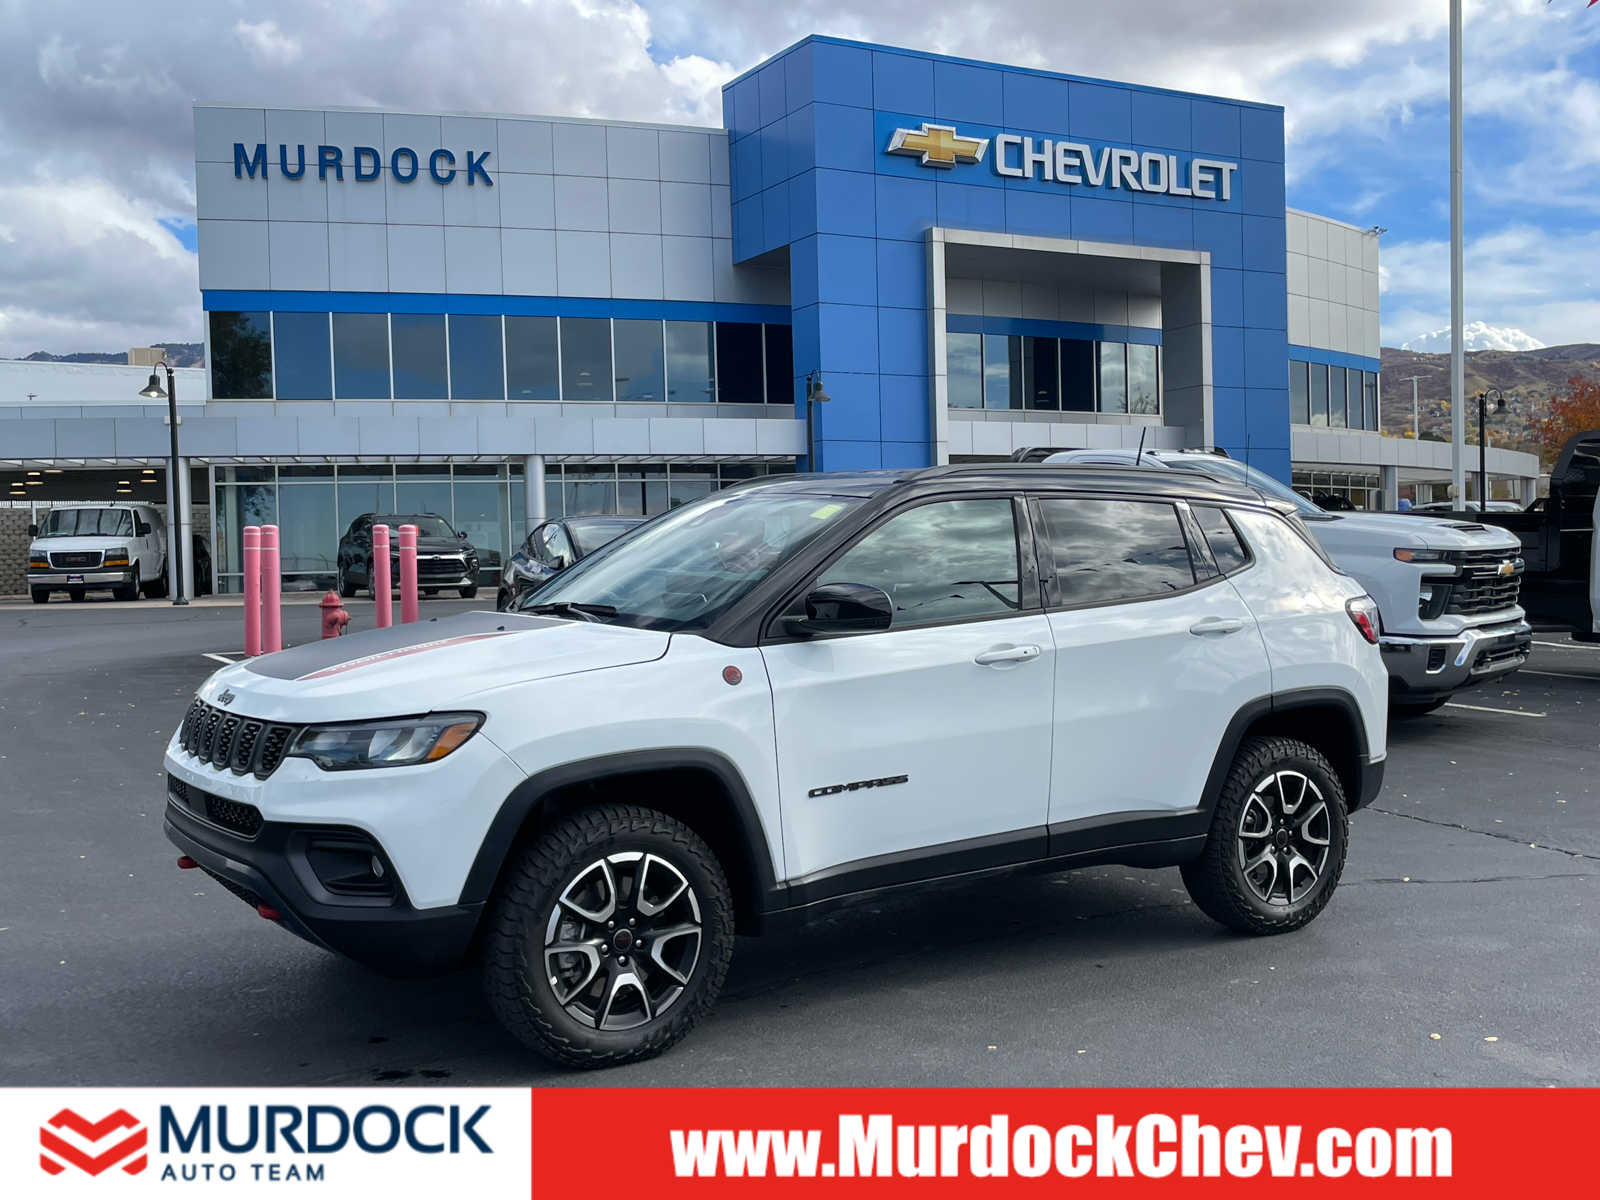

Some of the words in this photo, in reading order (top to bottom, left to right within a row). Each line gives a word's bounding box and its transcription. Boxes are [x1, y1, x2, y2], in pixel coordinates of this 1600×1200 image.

[233, 142, 495, 187] MURDOCK
[995, 133, 1239, 201] CHEVROLET
[808, 774, 909, 798] COMPASS
